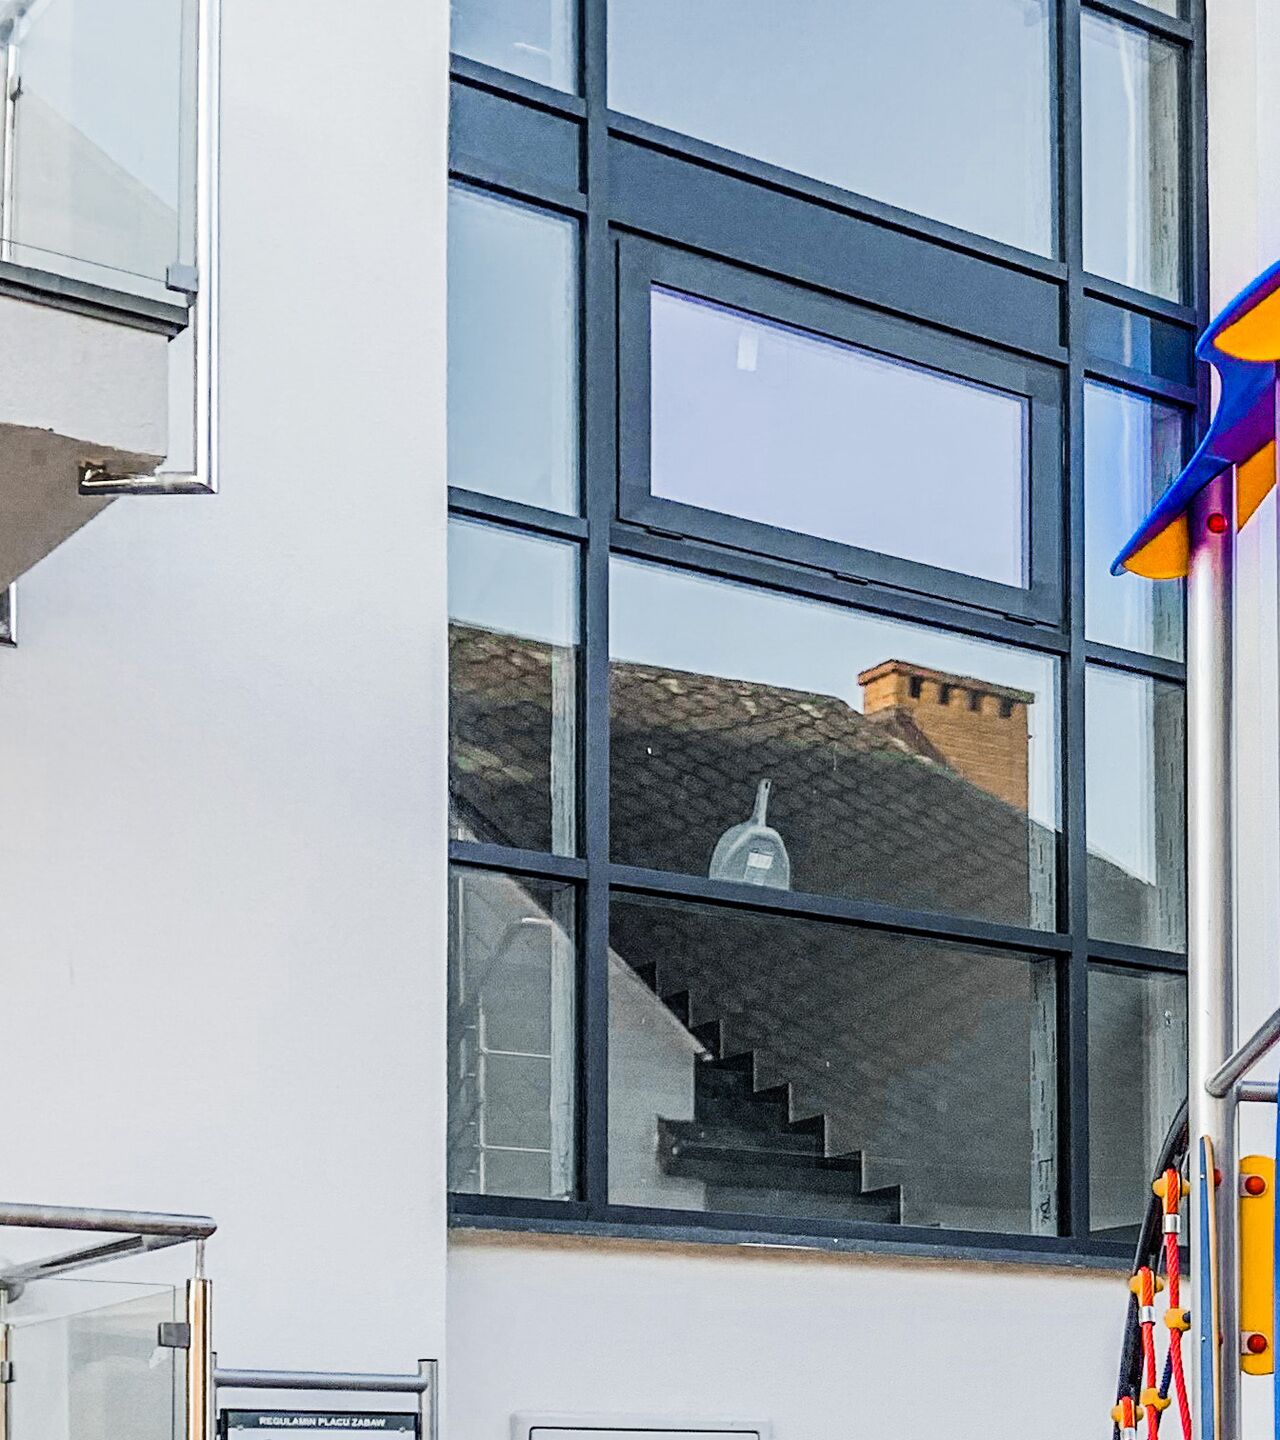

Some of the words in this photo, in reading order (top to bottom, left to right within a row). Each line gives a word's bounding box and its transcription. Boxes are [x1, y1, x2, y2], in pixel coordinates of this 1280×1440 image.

[259, 1416, 316, 1426] REGULAMIN
[318, 1417, 350, 1426] PLACU
[351, 1417, 386, 1427] ZABAW
